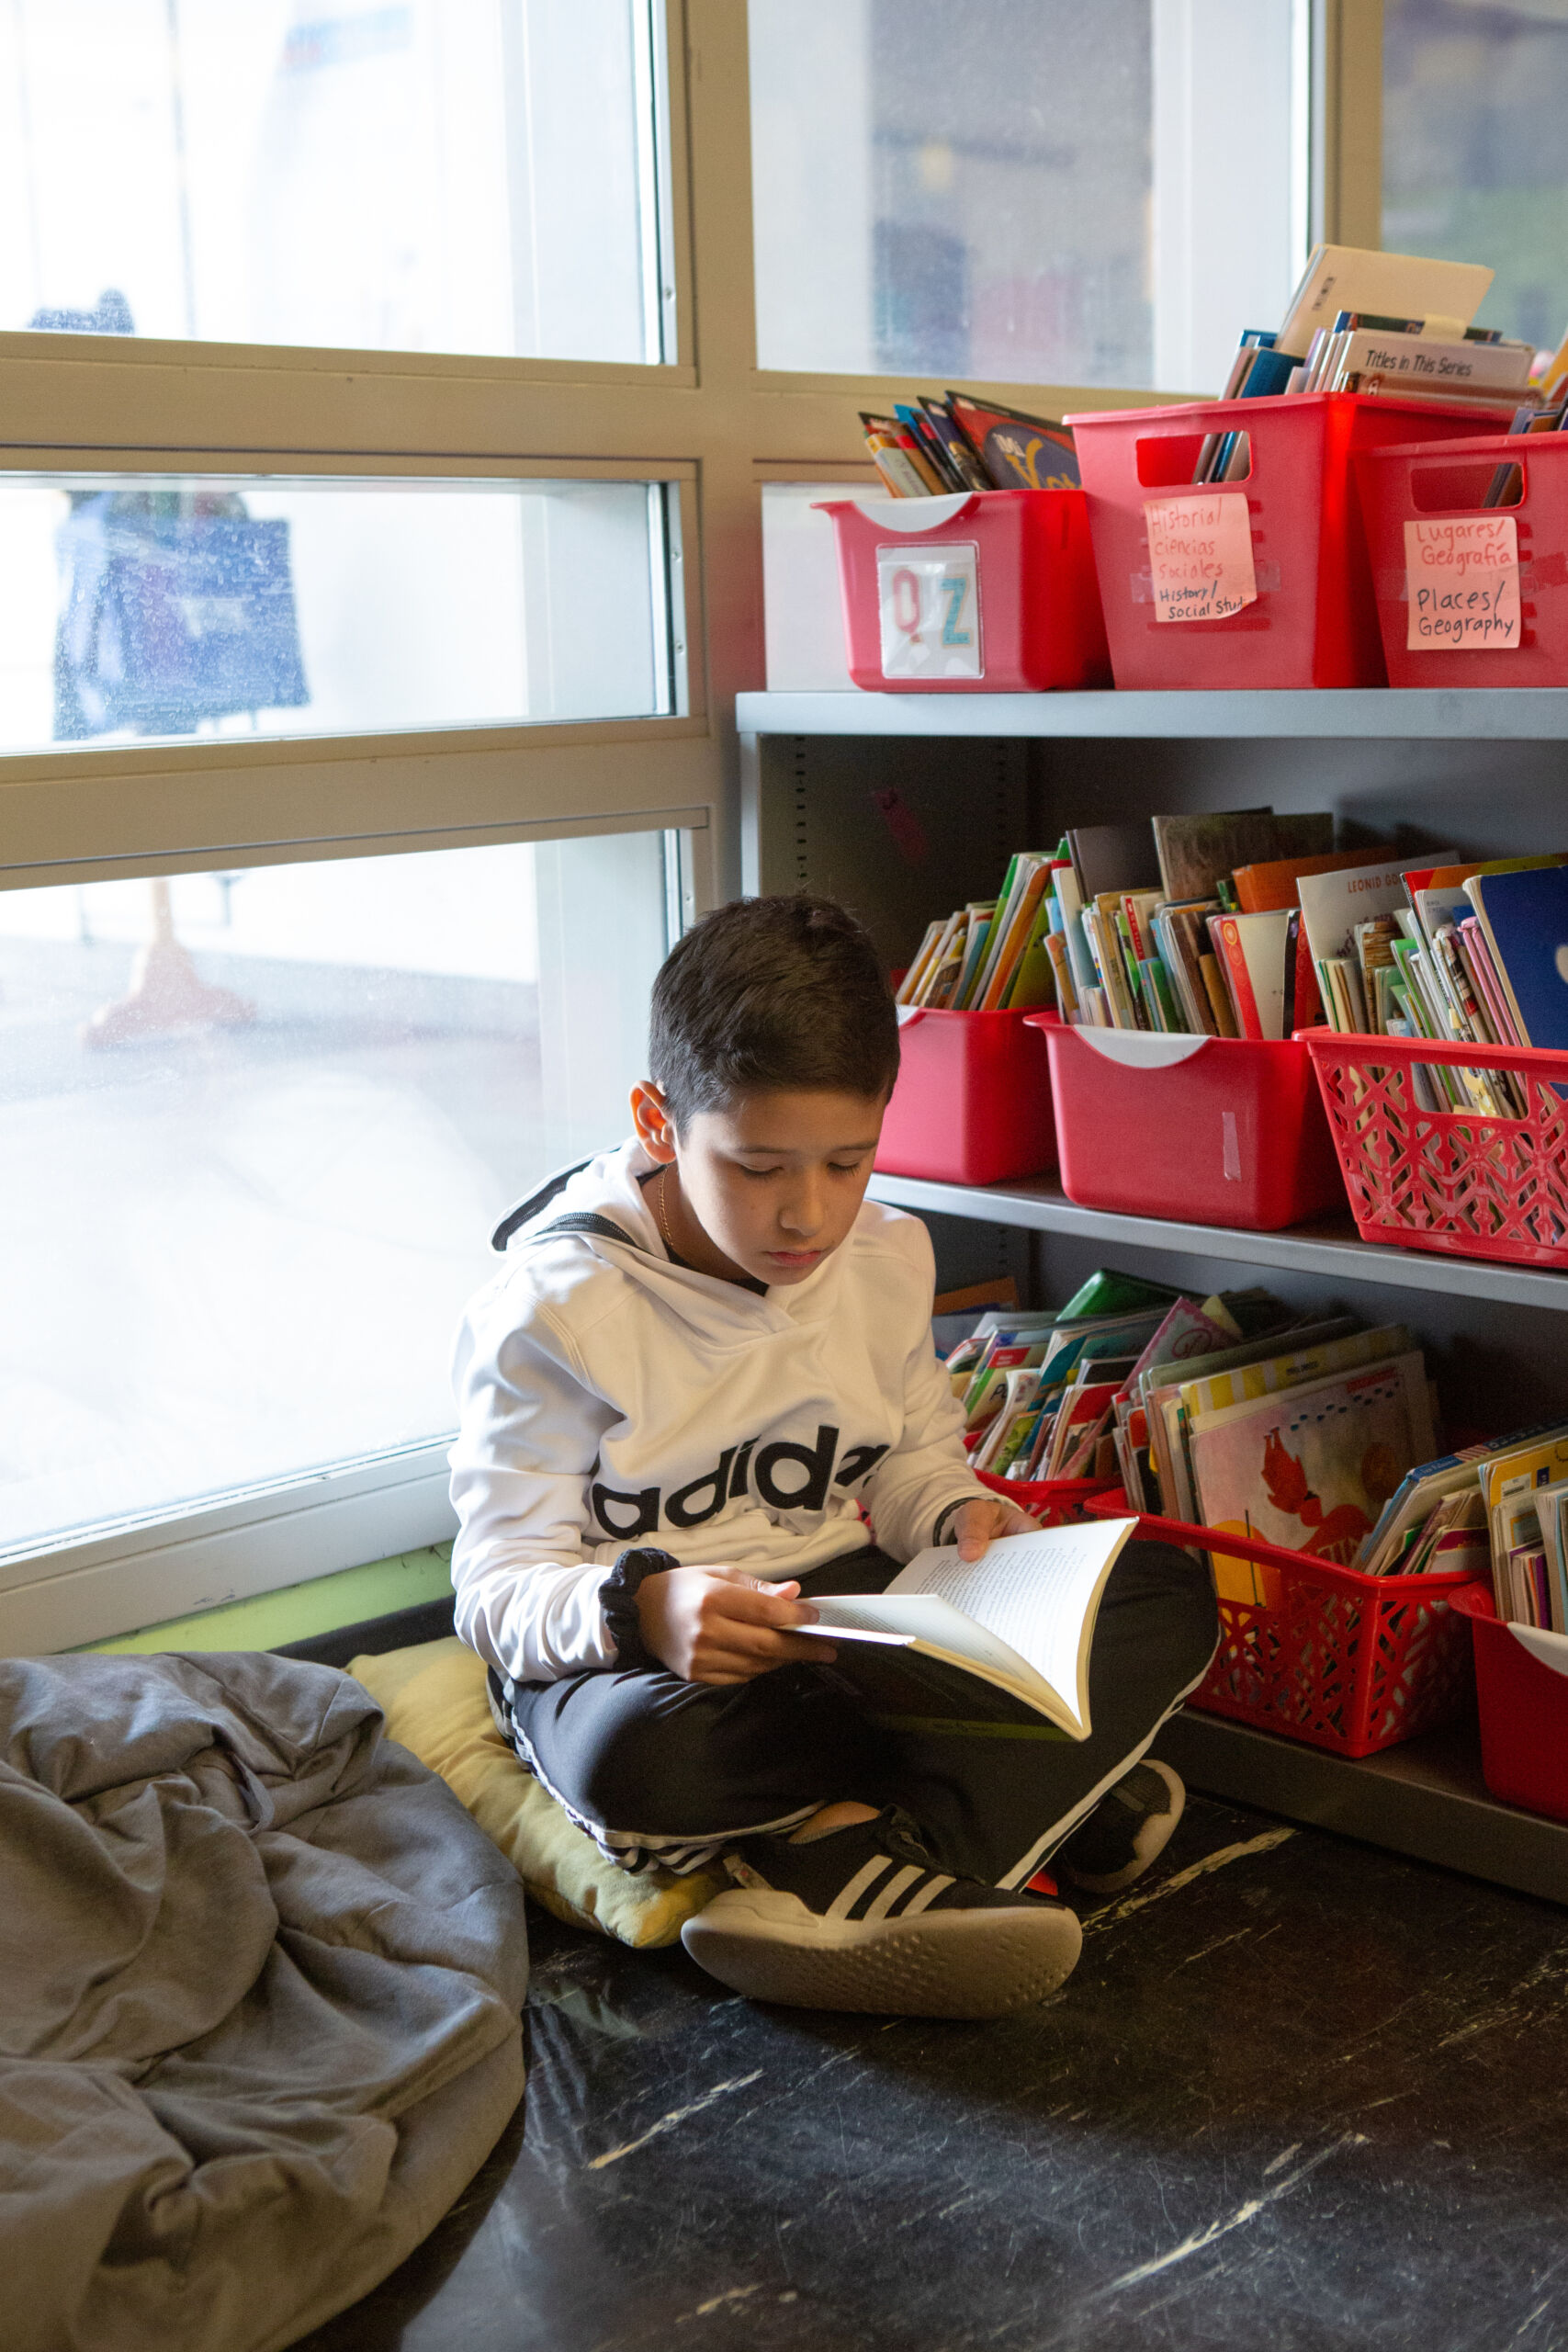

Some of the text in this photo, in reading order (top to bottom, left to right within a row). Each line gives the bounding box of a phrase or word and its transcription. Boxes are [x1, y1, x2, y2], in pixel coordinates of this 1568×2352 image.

[1366, 350, 1472, 377] Titles in This Series
[1416, 519, 1506, 549] Lugares/
[941, 577, 971, 646] Z
[1416, 581, 1506, 613] Places/
[1418, 613, 1514, 643] Geography
[1348, 874, 1401, 893] LEONID GO
